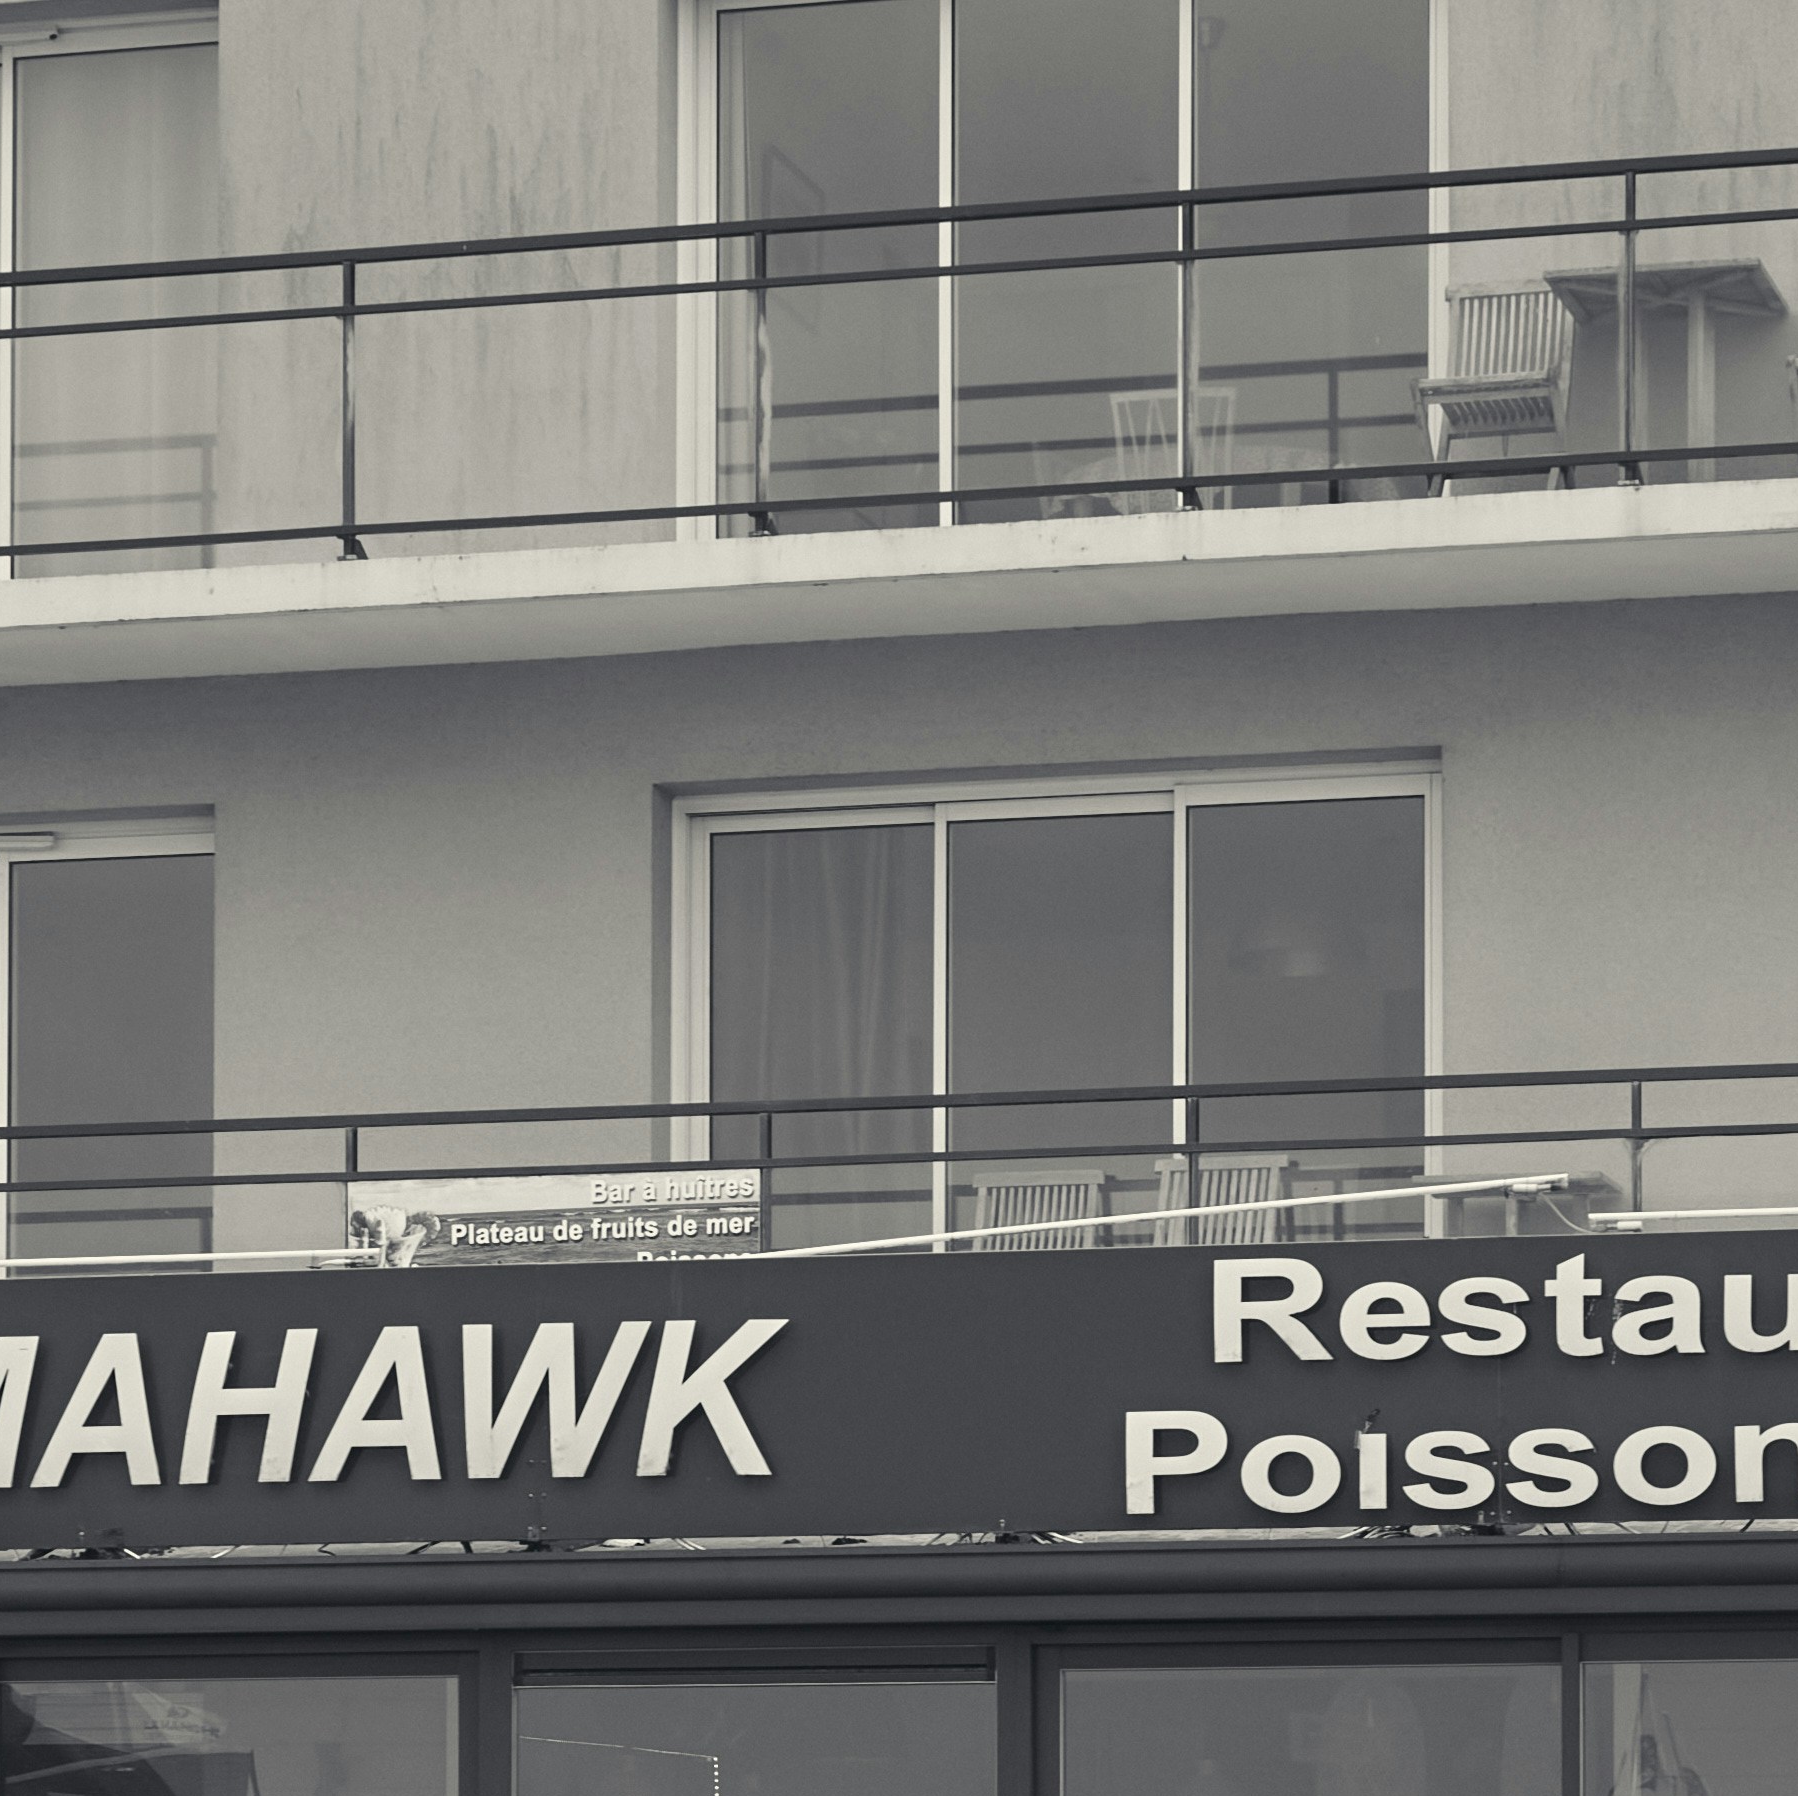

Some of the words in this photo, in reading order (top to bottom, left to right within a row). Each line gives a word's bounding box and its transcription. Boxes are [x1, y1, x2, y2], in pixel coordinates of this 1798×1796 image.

[591, 1180, 634, 1203] Bar
[643, 1181, 657, 1201] à
[666, 1177, 755, 1200] huîtres
[450, 1222, 544, 1245] Plateau
[553, 1220, 583, 1242] de
[591, 1218, 659, 1240] fruits
[668, 1216, 697, 1237] de
[706, 1214, 755, 1235] mer
